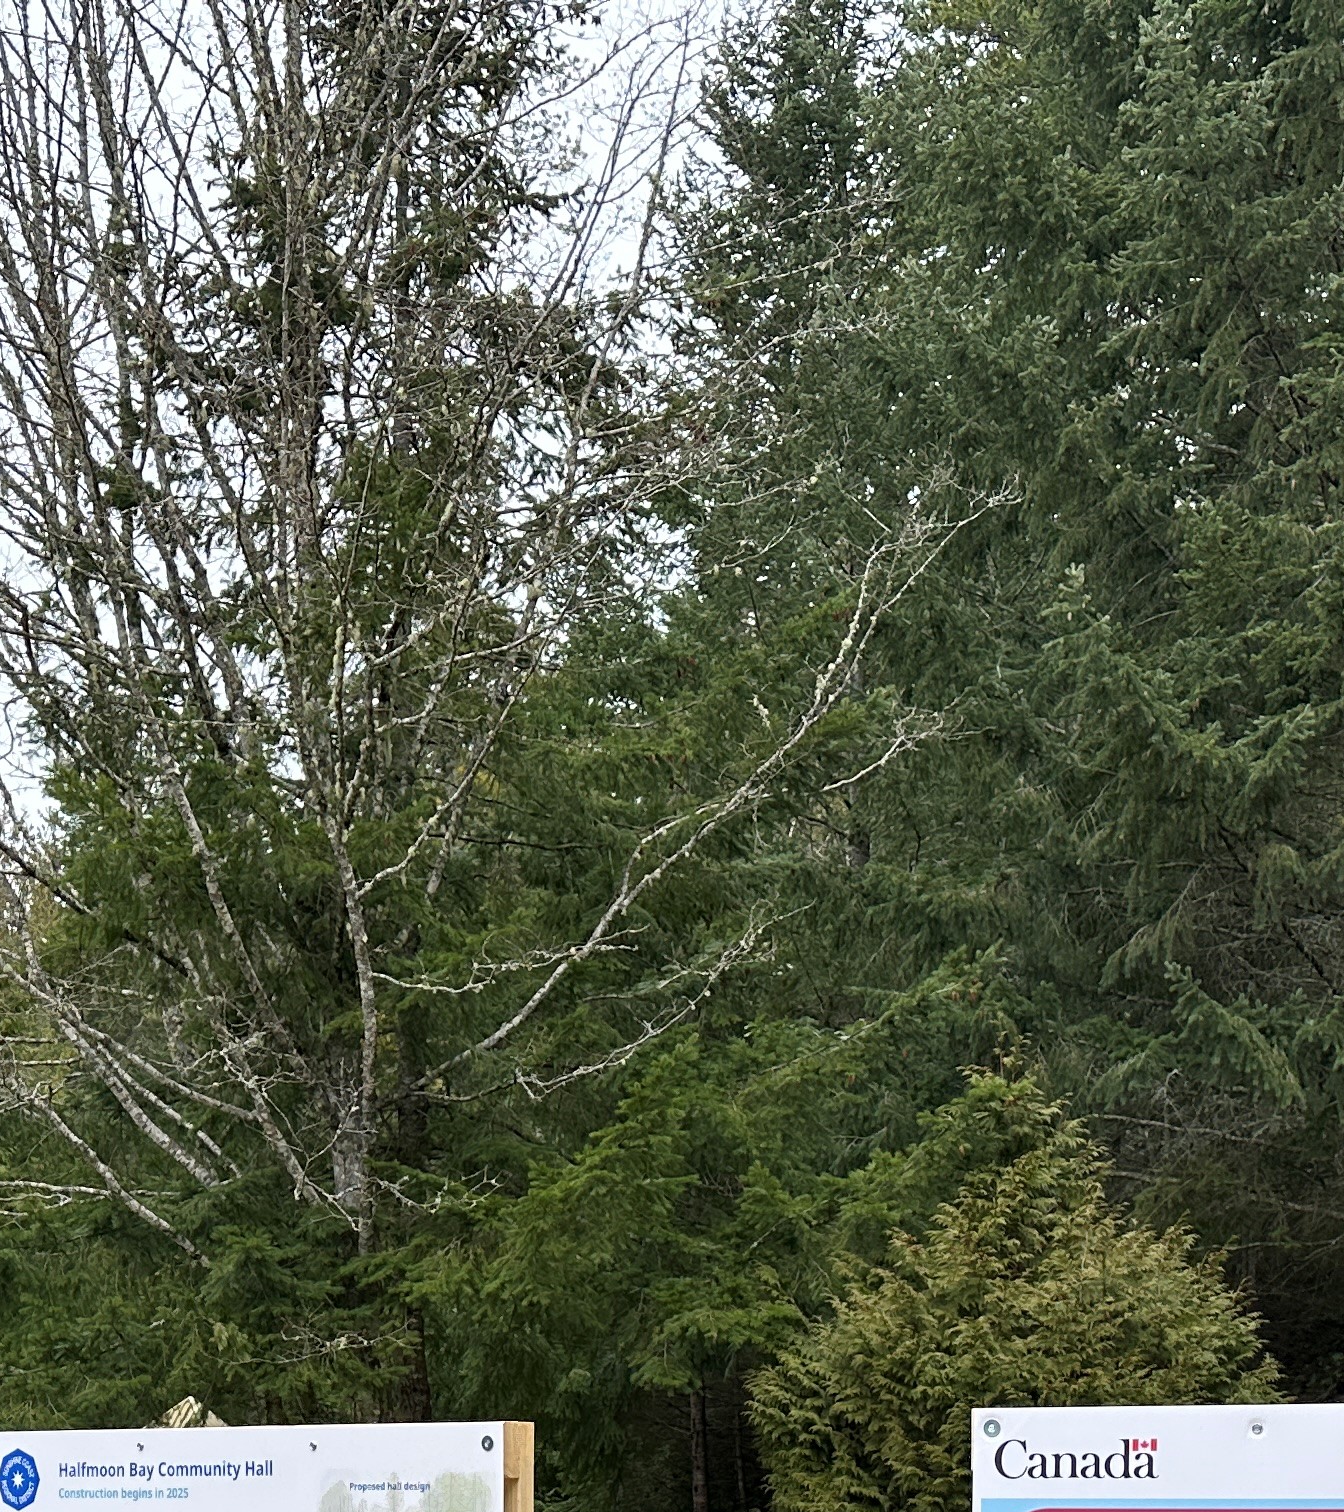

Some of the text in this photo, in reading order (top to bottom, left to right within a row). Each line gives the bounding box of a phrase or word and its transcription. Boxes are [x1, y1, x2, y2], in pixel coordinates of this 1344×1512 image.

[994, 1438, 1160, 1480] Canada
[58, 1459, 274, 1482] Halfmoon Bay Community Hall
[58, 1487, 189, 1502] Construction begins in 2025
[350, 1482, 431, 1493] Proposed hall design
